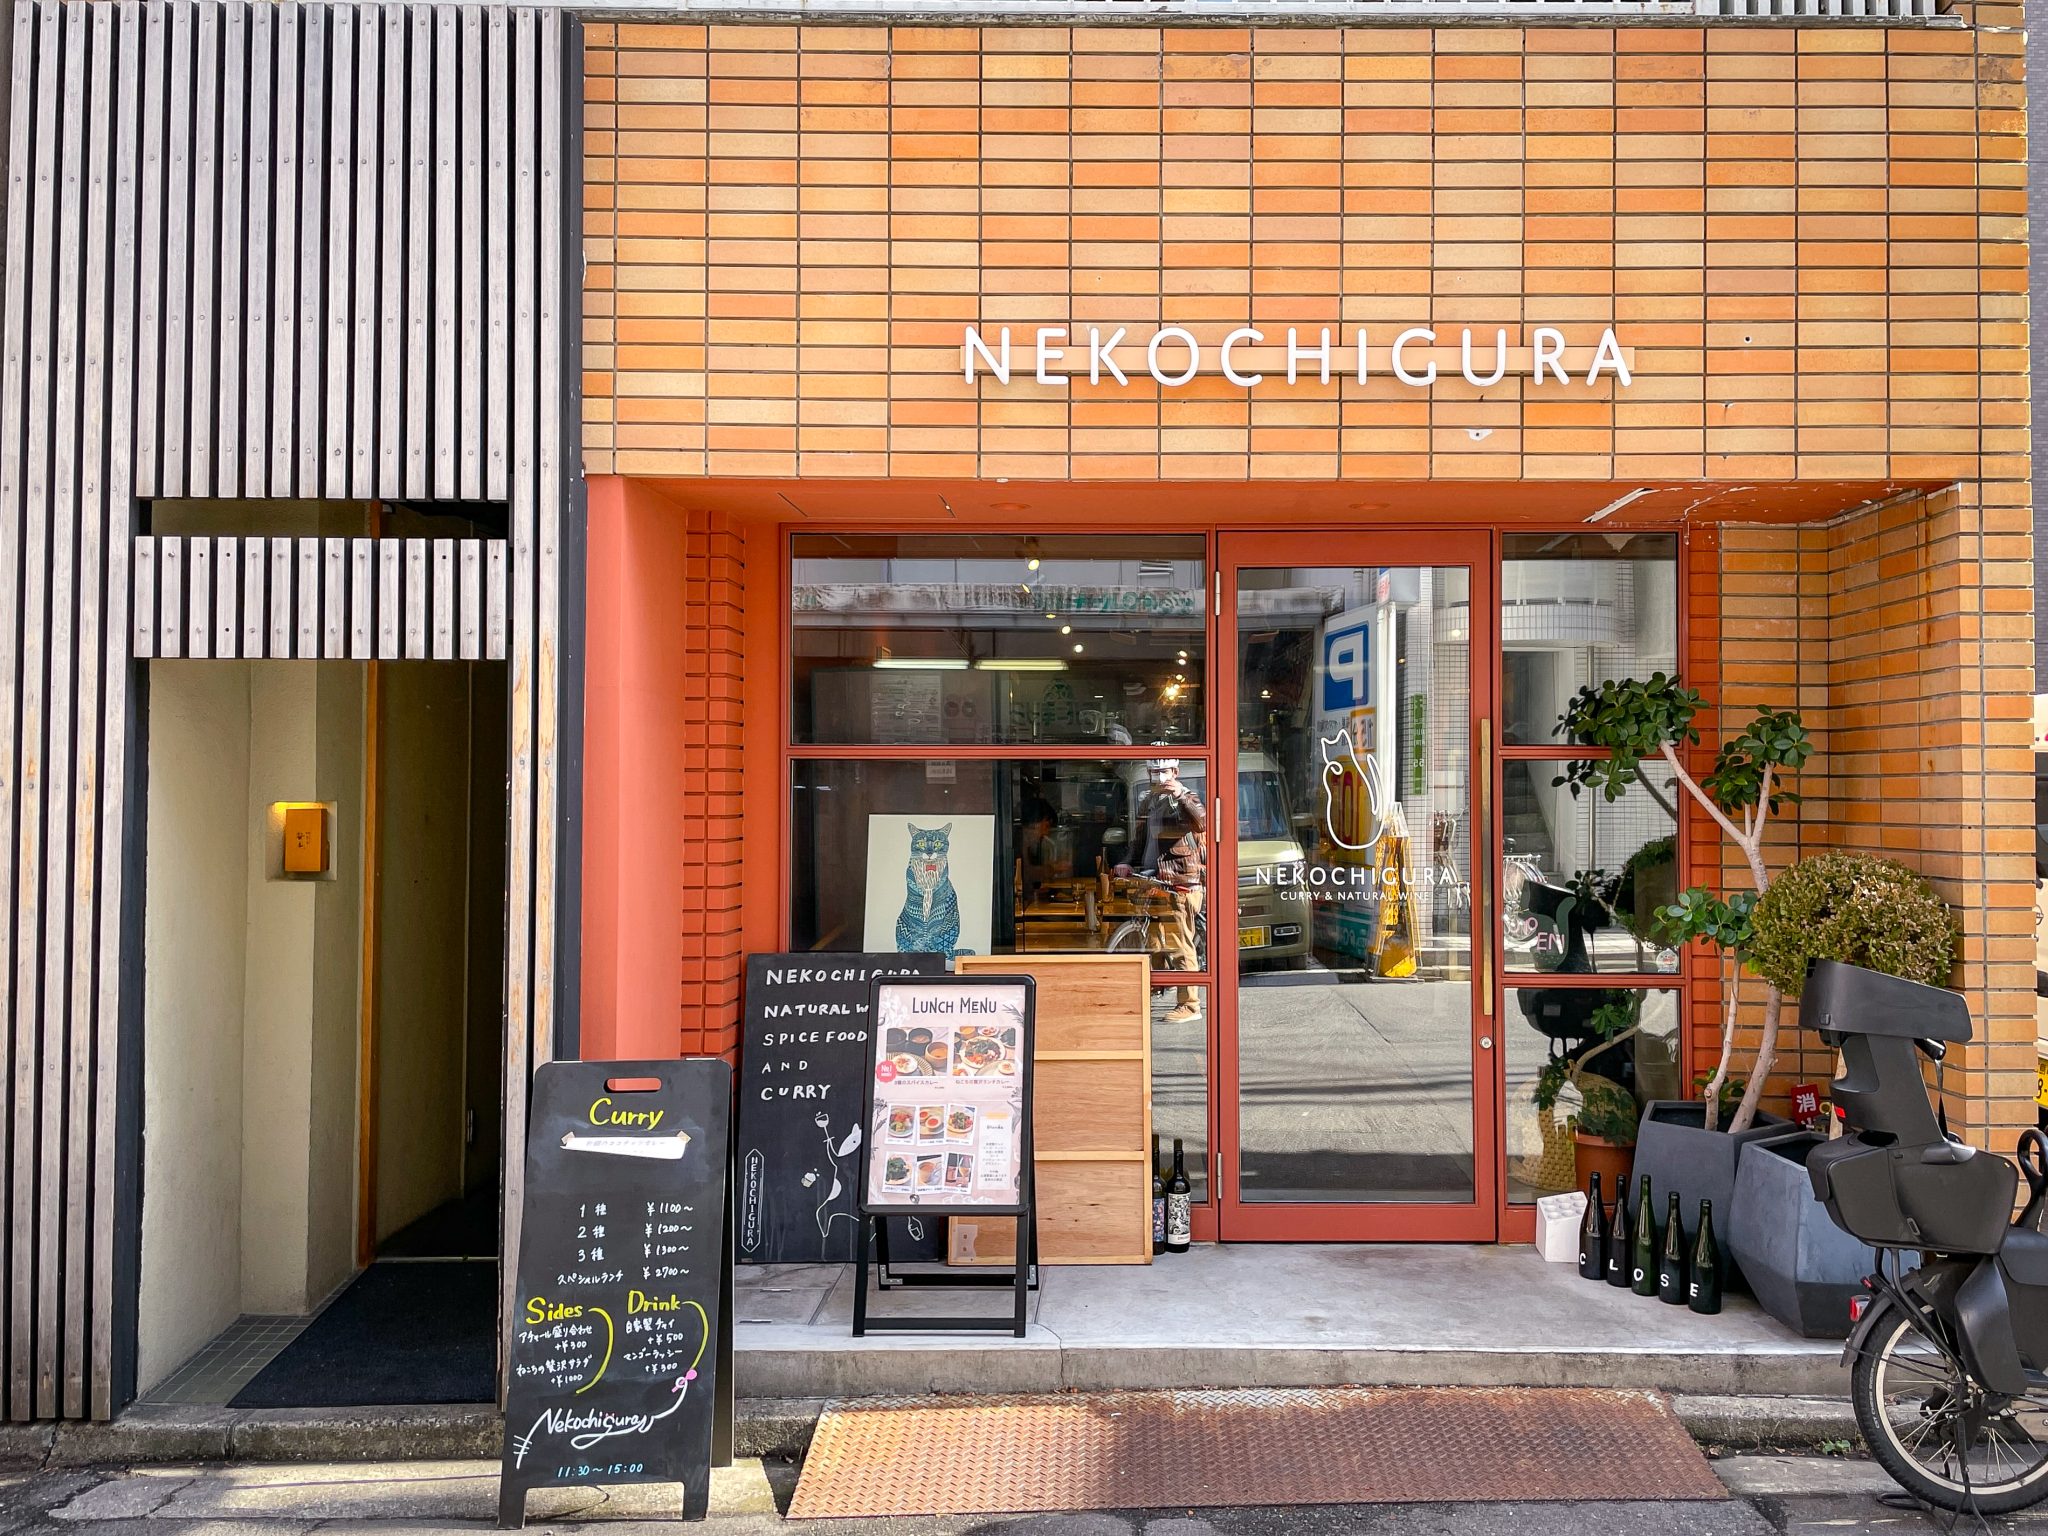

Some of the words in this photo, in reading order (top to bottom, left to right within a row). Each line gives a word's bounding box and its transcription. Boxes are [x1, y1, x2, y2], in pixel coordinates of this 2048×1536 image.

[965, 326, 1632, 387] NEKOCHIGURA
[1255, 867, 1453, 886] NEKOCHIGURA
[1280, 891, 1320, 901] CURRY
[1325, 891, 1333, 901] &
[1343, 891, 1394, 901] NATURAL
[1398, 891, 1429, 901] WINE
[764, 1003, 850, 1018] NATURAL
[912, 997, 954, 1014] LUNCH
[959, 997, 998, 1014] MENU
[763, 1031, 820, 1046] SPICE
[826, 1030, 868, 1043] FOOD
[761, 1061, 808, 1073] AND
[761, 1084, 831, 1100] CURRY
[589, 1097, 664, 1130] Curry
[746, 1156, 758, 1246] NEKOCHIGURA
[525, 1296, 583, 1324] Sides
[627, 1289, 681, 1315] Drink
[623, 1346, 683, 1361] マンゴーラッシー
